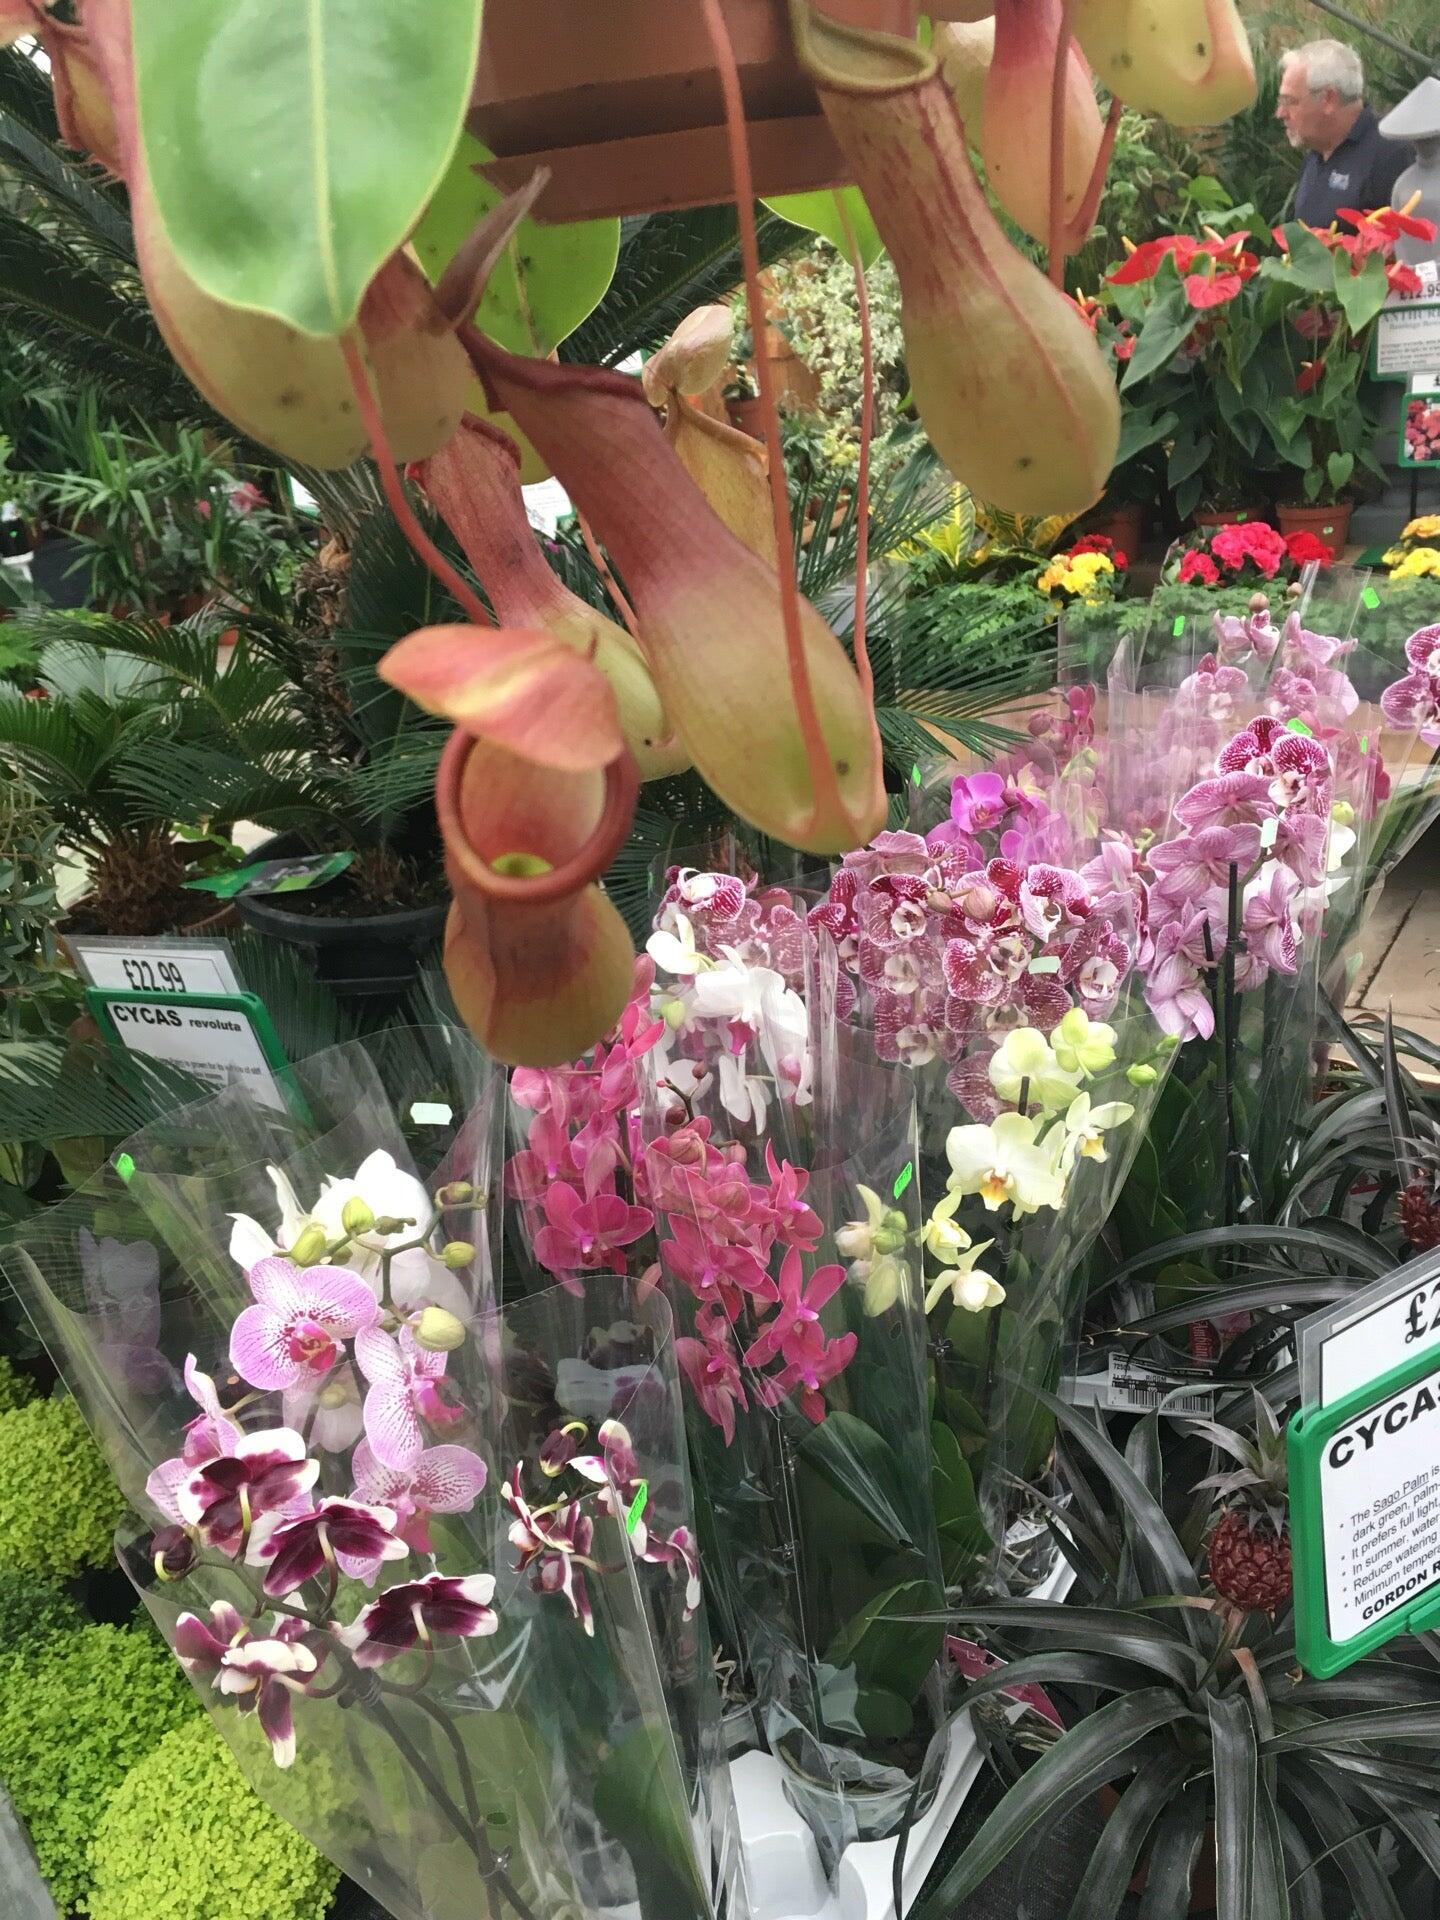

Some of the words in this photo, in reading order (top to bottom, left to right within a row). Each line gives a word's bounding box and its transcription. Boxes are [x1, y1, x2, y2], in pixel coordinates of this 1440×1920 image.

[122, 958, 187, 993] £22.99
[113, 1004, 183, 1028] CYCAS
[189, 1017, 242, 1032] revoluta
[1329, 1381, 1440, 1469] CYCA
[1350, 1509, 1371, 1527] The
[1373, 1490, 1401, 1514] Sago
[1402, 1472, 1429, 1494] Palm
[1352, 1521, 1376, 1542] dark
[1352, 1548, 1359, 1560] It
[1361, 1525, 1398, 1557] prefers
[1400, 1511, 1415, 1530] full
[1352, 1563, 1363, 1576] In
[1353, 1560, 1393, 1592] Reduce
[1395, 1531, 1438, 1564] watering
[1354, 1571, 1401, 1608] Minimum
[1362, 1568, 1428, 1620] GORDON
